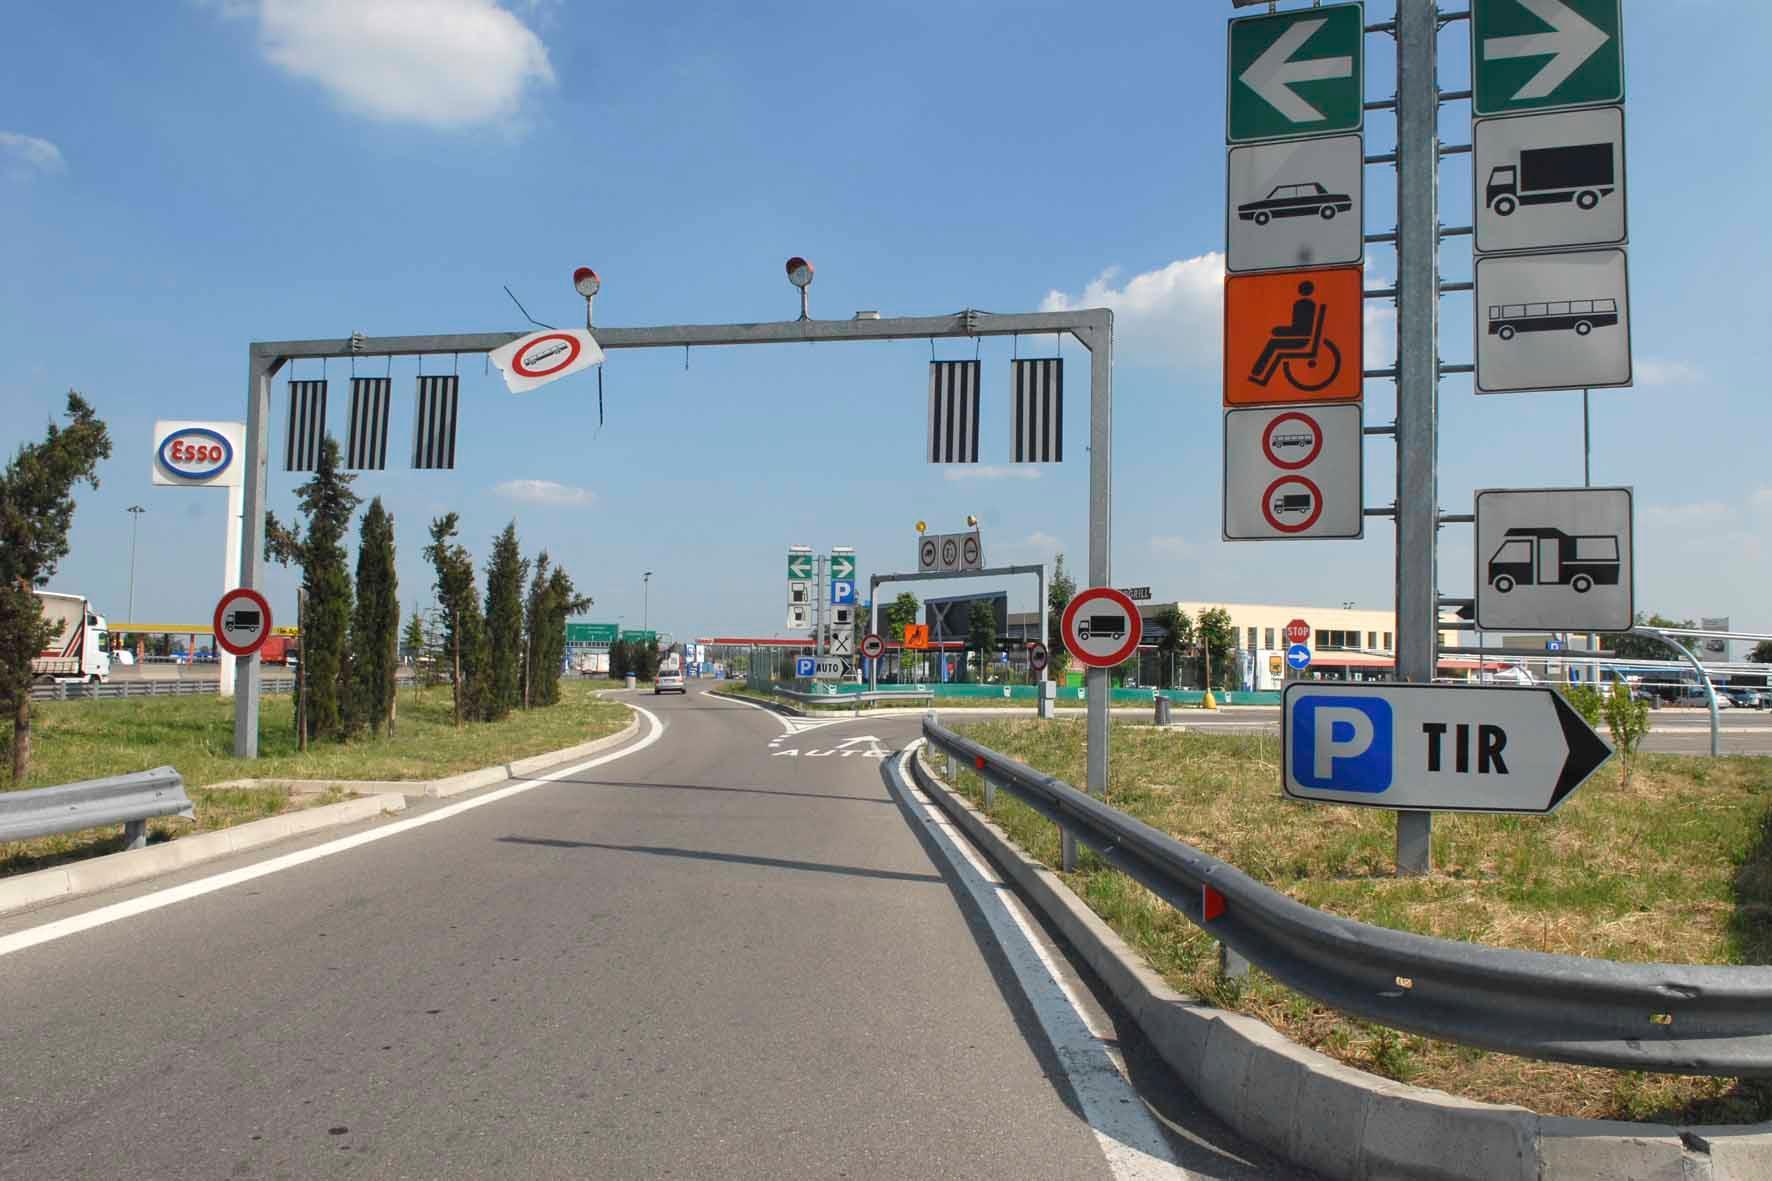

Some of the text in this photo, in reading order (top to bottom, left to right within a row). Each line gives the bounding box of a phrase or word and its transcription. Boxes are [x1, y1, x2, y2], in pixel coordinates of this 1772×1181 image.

[834, 582, 851, 603] P
[1287, 625, 1310, 637] STOP
[800, 660, 839, 675] P AUTO
[1314, 706, 1509, 779] P TIR
[771, 749, 889, 757] AUTO
